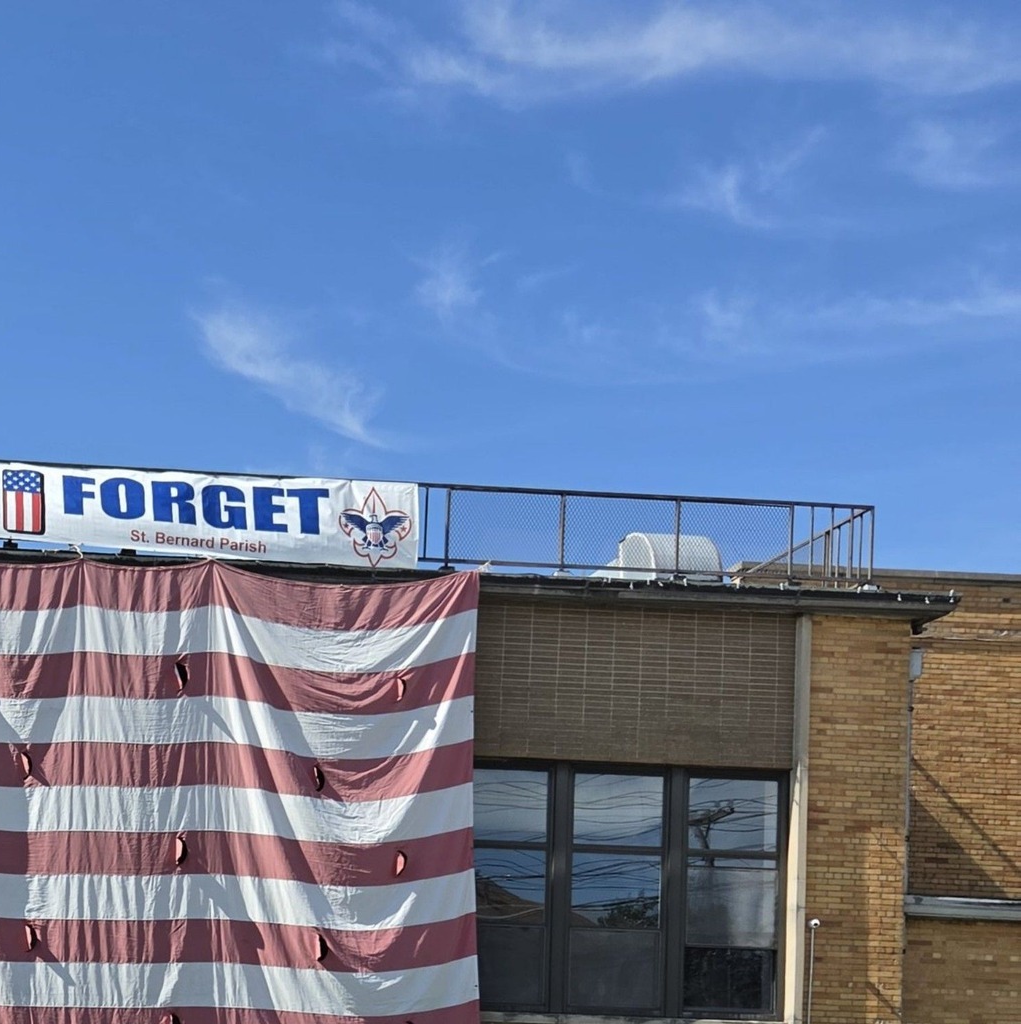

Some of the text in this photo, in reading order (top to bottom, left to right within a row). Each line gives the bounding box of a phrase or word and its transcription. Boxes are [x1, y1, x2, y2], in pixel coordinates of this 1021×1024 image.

[61, 475, 330, 535] FORGET
[130, 529, 267, 554] St. Bernard Parish
